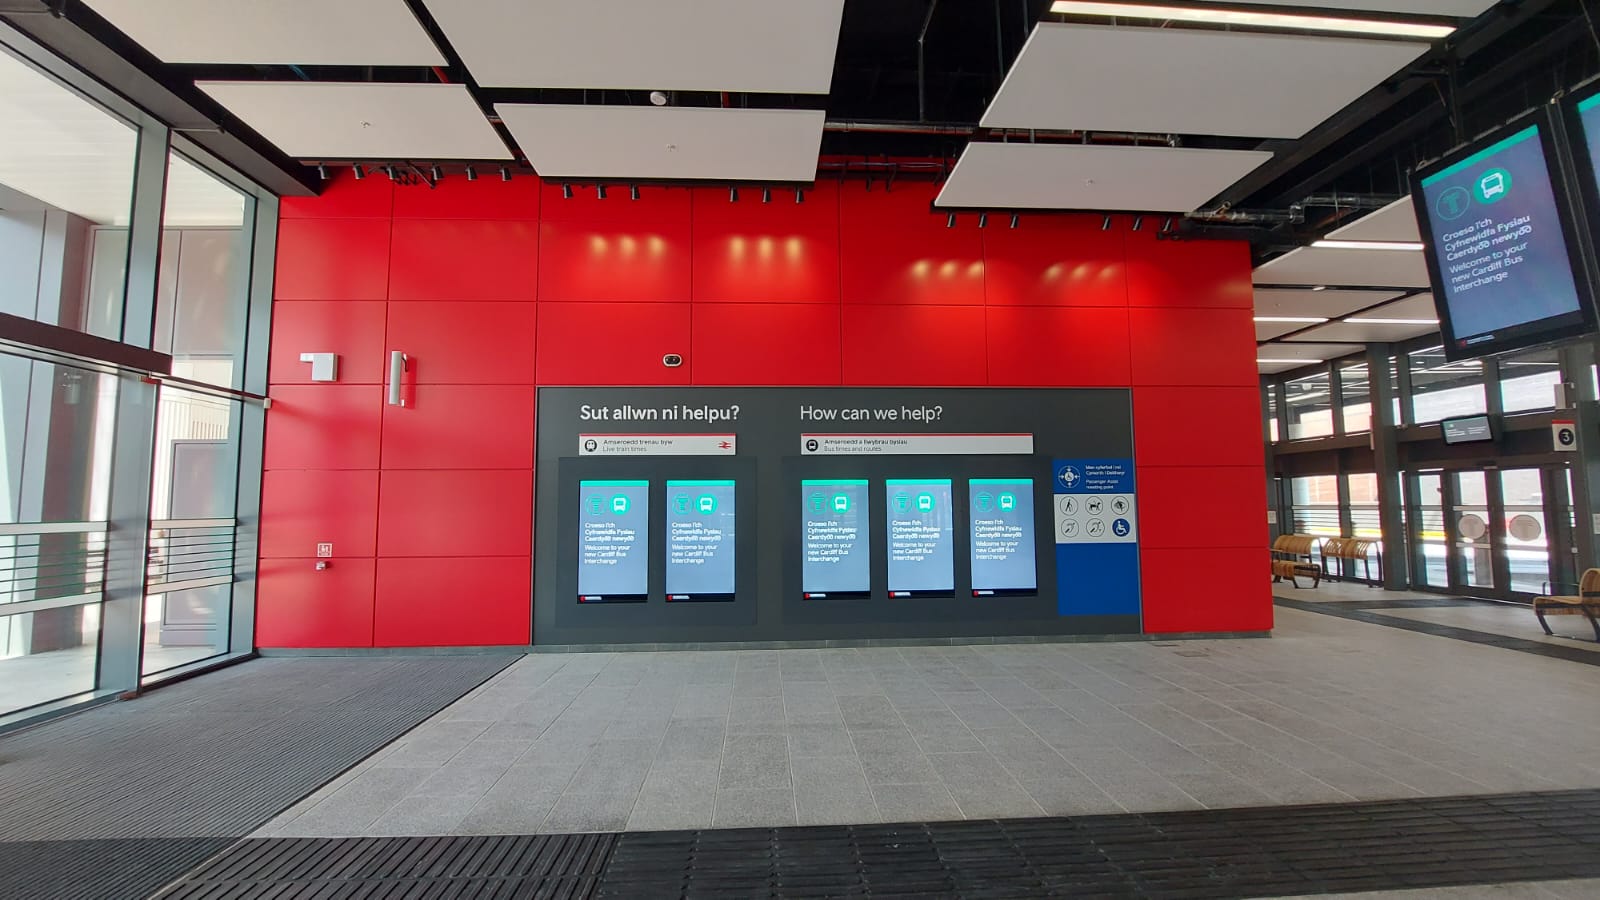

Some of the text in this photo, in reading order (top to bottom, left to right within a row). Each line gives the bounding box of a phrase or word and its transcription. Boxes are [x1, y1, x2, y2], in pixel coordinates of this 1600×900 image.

[1442, 225, 1474, 242] Croeso
[1444, 216, 1530, 252] Cyfnewidfa Fysiau
[1449, 242, 1528, 274] Welcome to your
[1452, 255, 1524, 284] new Cardiff Bus
[1454, 271, 1508, 293] Interchange
[580, 404, 740, 424] Sut allwn ni helpu?
[800, 405, 943, 424] How can we help?
[1562, 432, 1570, 442] 3
